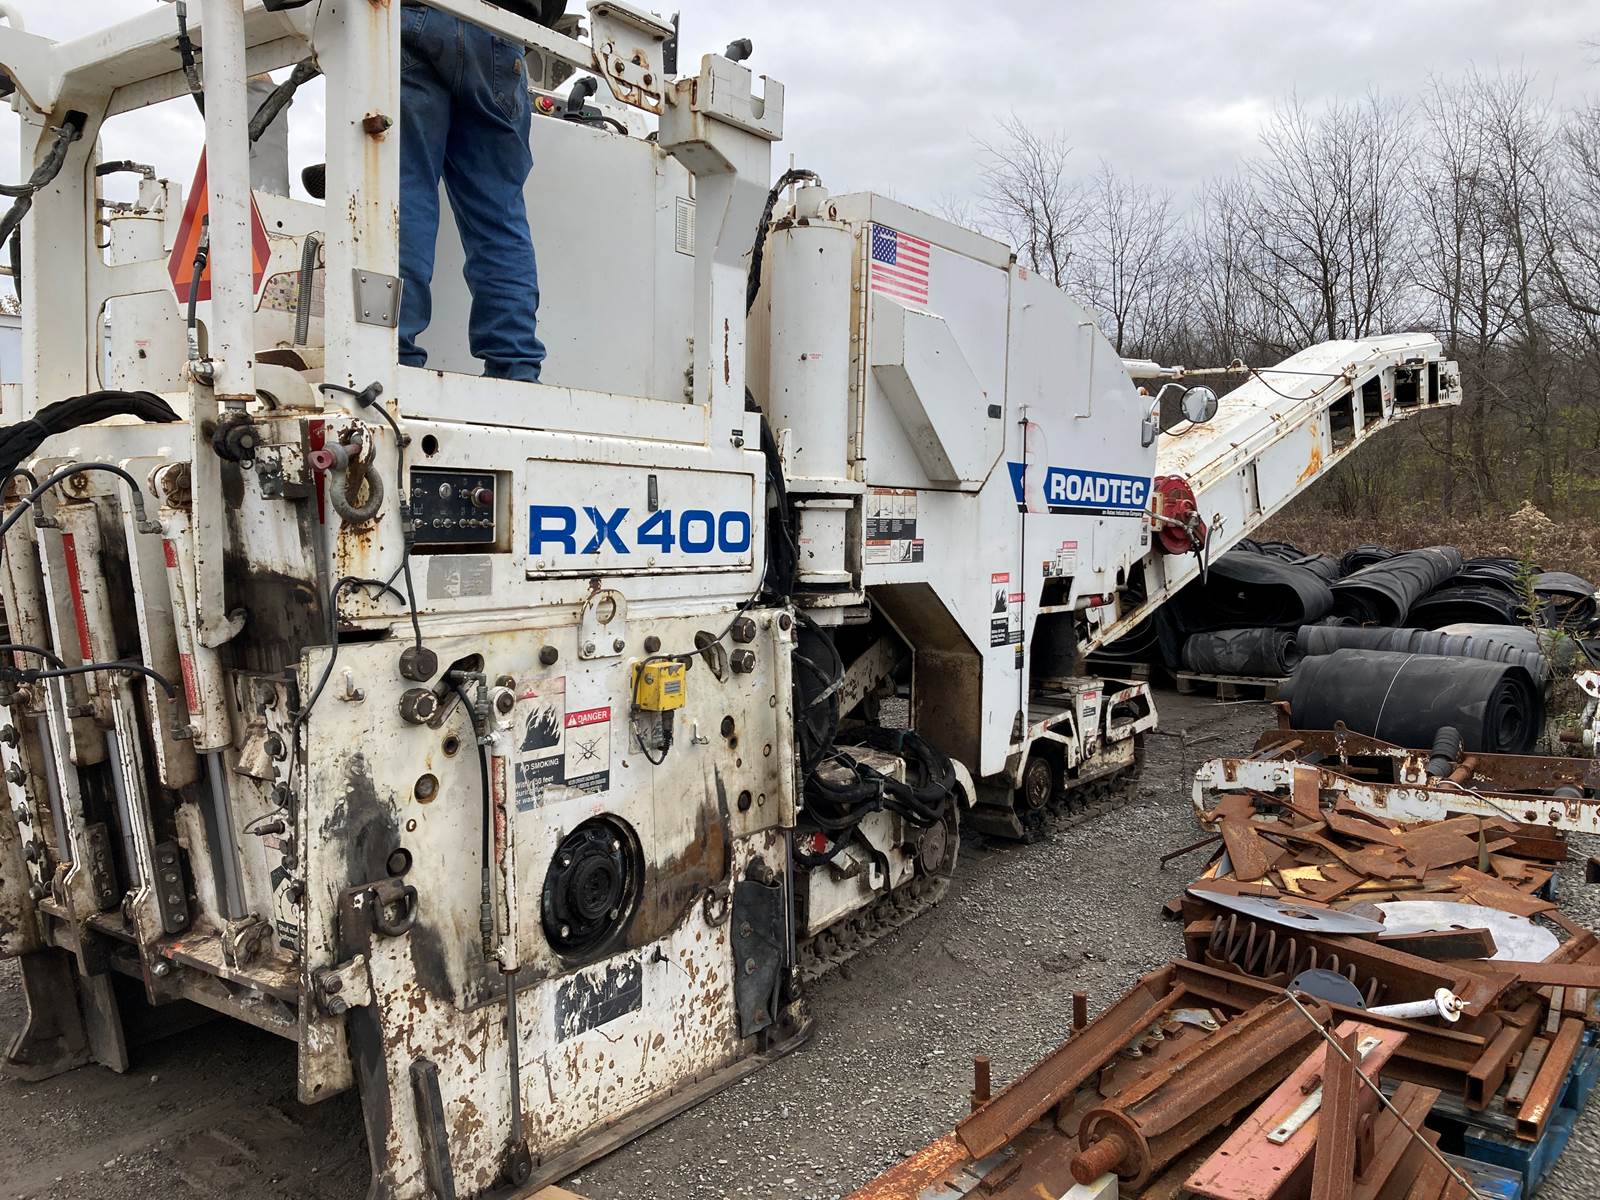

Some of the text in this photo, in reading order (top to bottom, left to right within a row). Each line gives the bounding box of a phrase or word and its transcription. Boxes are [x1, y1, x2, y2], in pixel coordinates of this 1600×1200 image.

[1050, 473, 1144, 505] ROADTEC
[577, 711, 607, 724] DANGER
[530, 758, 559, 771] SMOKING
